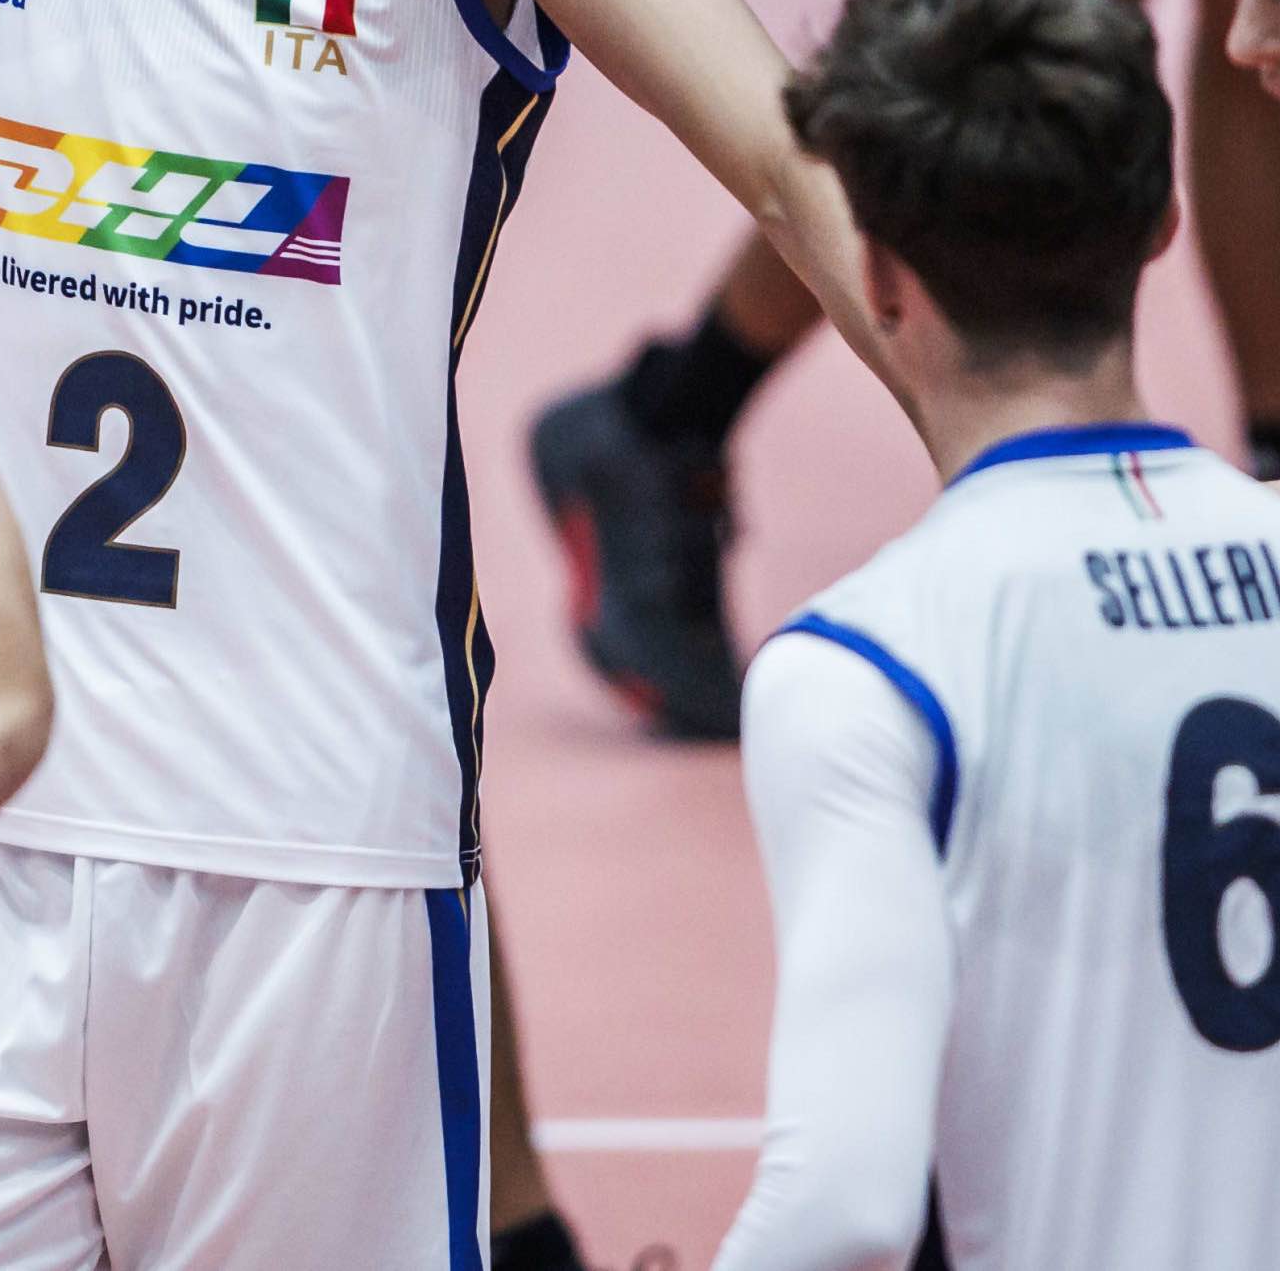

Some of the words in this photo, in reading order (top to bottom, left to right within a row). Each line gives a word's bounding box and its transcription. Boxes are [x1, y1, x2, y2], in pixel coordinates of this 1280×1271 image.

[263, 29, 348, 77] ITA
[102, 281, 169, 317] with
[178, 296, 272, 331] pride.
[40, 349, 187, 610] 2
